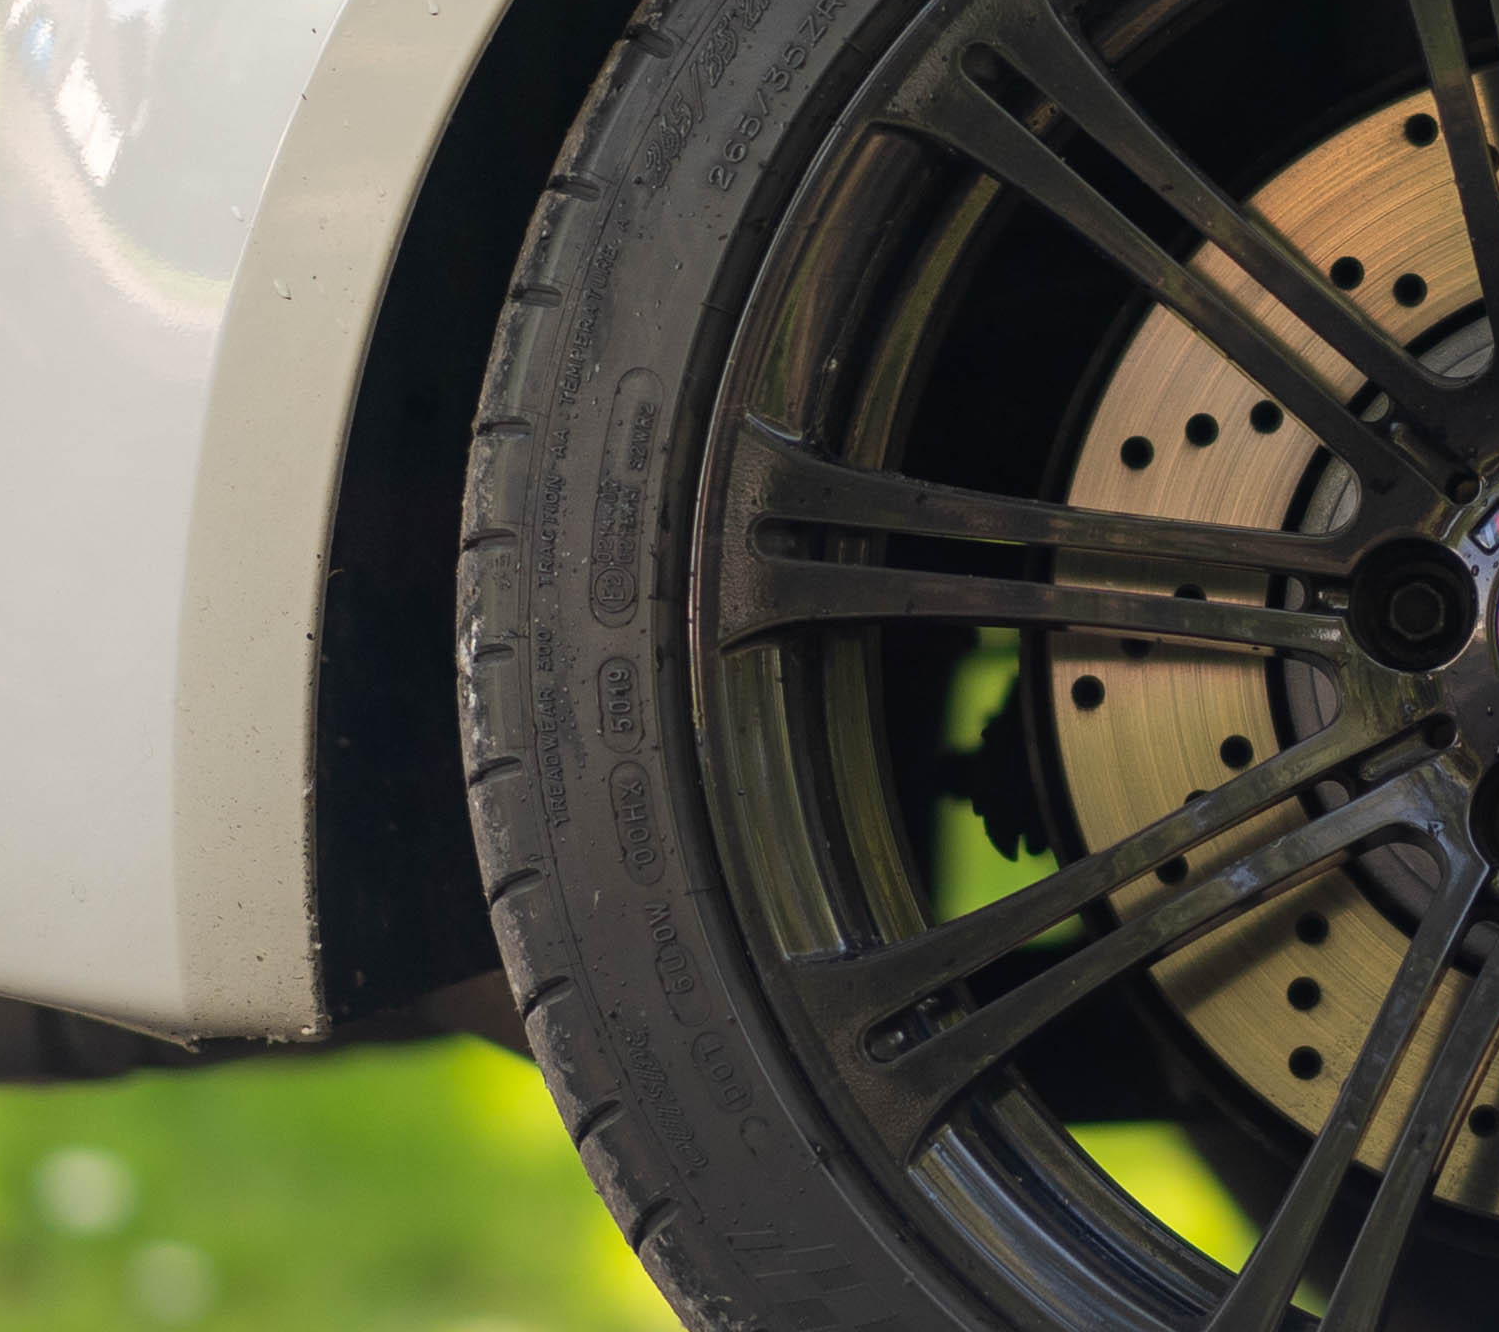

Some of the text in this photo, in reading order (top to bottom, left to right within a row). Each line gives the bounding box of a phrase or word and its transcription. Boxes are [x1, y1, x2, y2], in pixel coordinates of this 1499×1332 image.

[556, 243, 622, 409] TEMPERATURE
[535, 474, 564, 589] TRACTION
[604, 666, 635, 735] 5019
[535, 688, 574, 831] TREADWEAR
[695, 1031, 751, 1109] DOT
